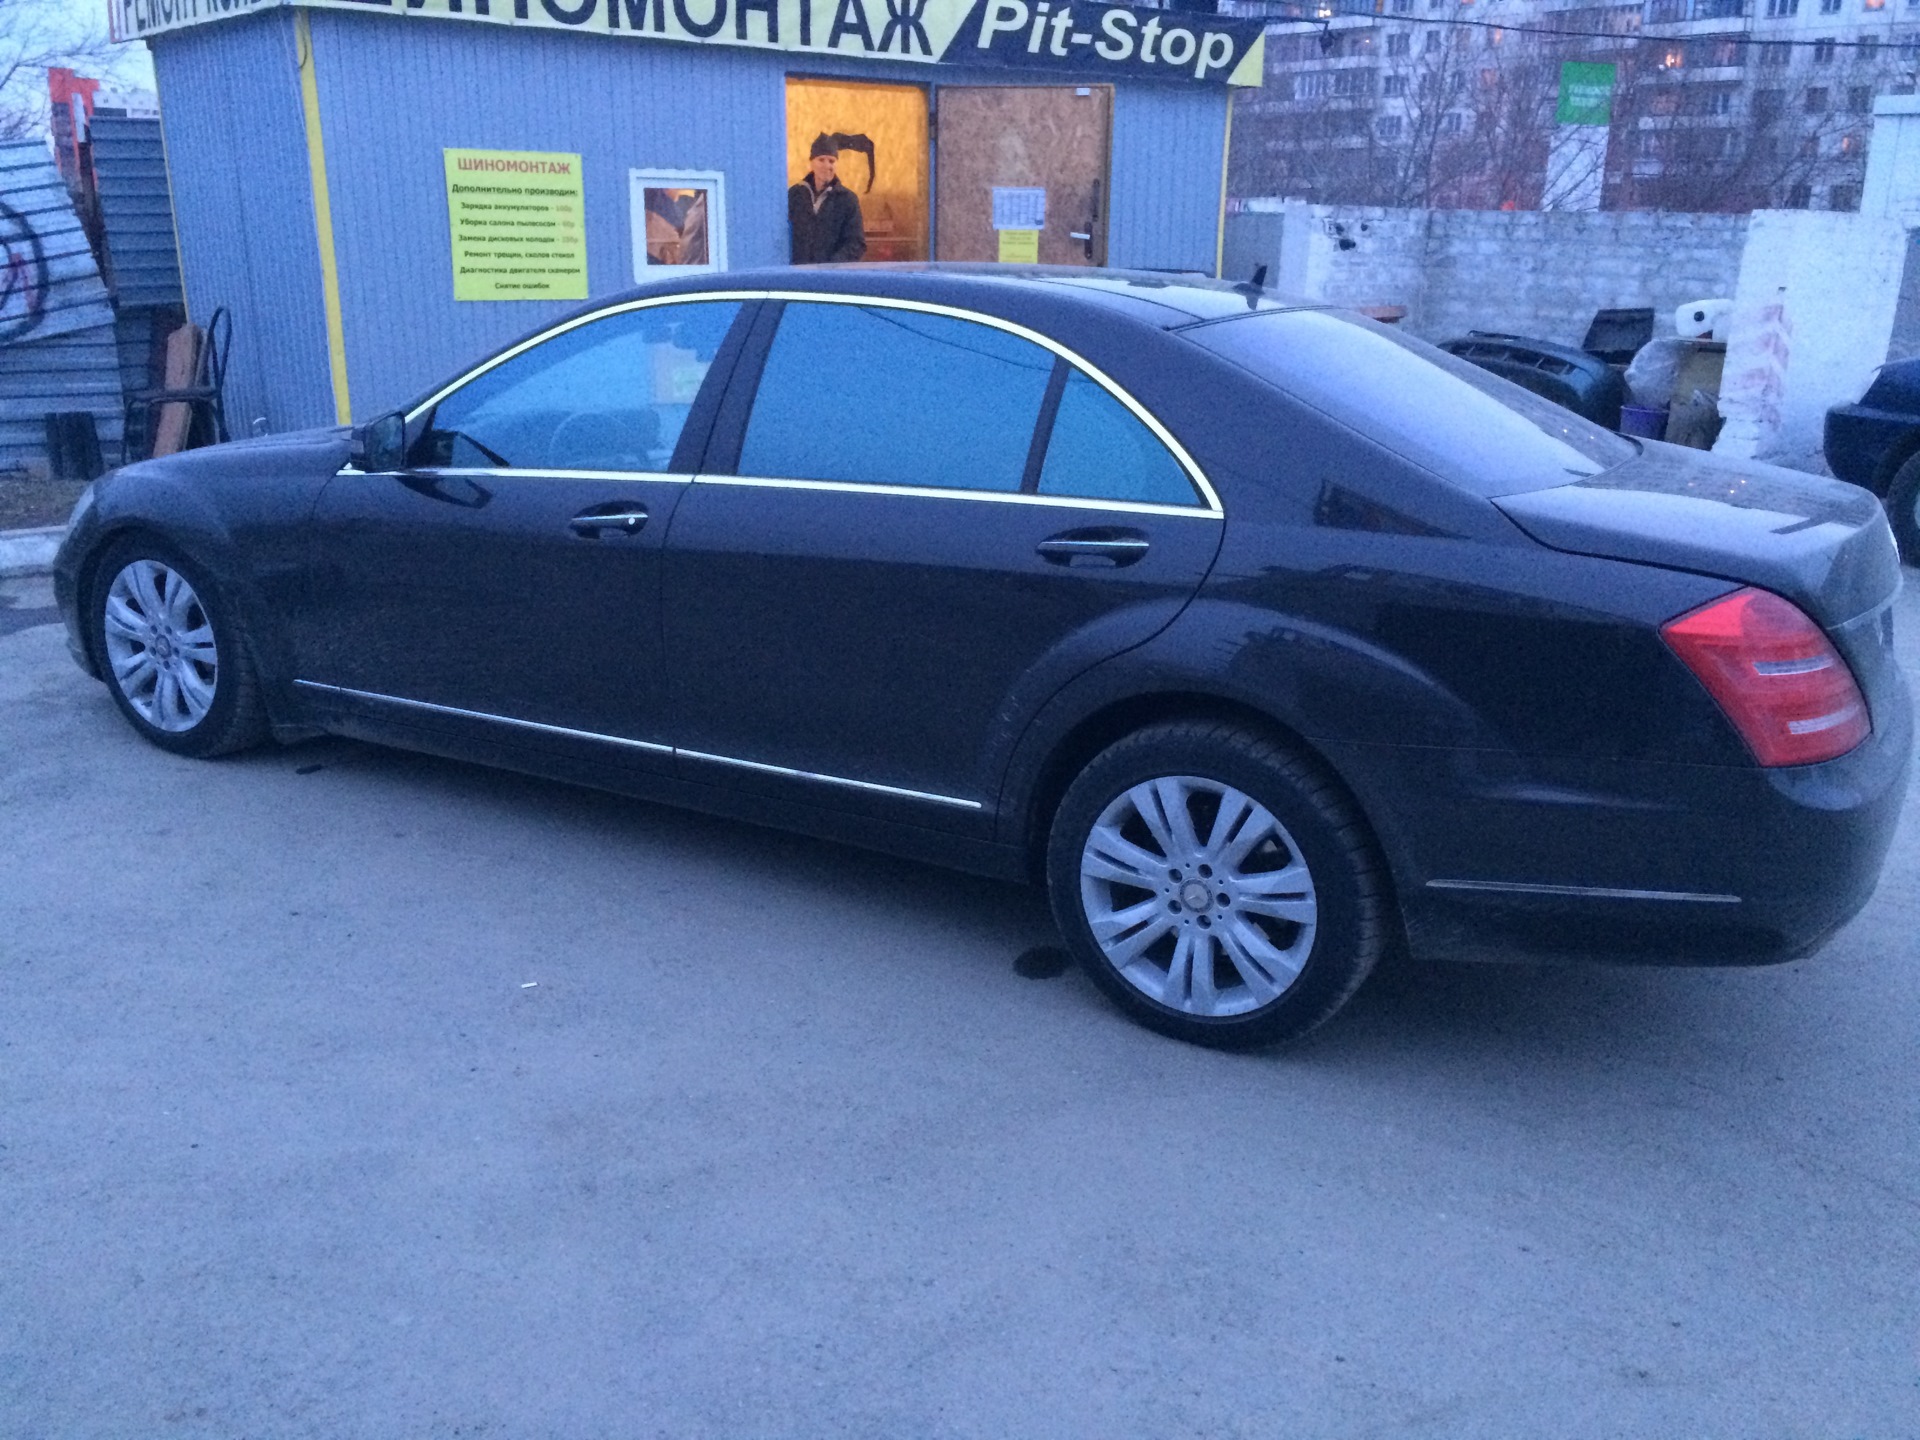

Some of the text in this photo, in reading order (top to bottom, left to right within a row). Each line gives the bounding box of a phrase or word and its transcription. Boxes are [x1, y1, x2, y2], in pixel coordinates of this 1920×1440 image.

[977, 0, 1235, 79] Pit-Stop
[457, 157, 571, 174] ШИНОМОНТАЖ
[452, 183, 578, 197] Дополнительно производим:
[461, 201, 492, 210] Зарядка
[494, 204, 549, 212] аккумуляторов
[460, 218, 487, 227] Уборка
[458, 234, 486, 242] Замена
[464, 250, 491, 258] Ремонт
[459, 266, 508, 274] Диагностика
[494, 282, 550, 290] Снятие ошибок
